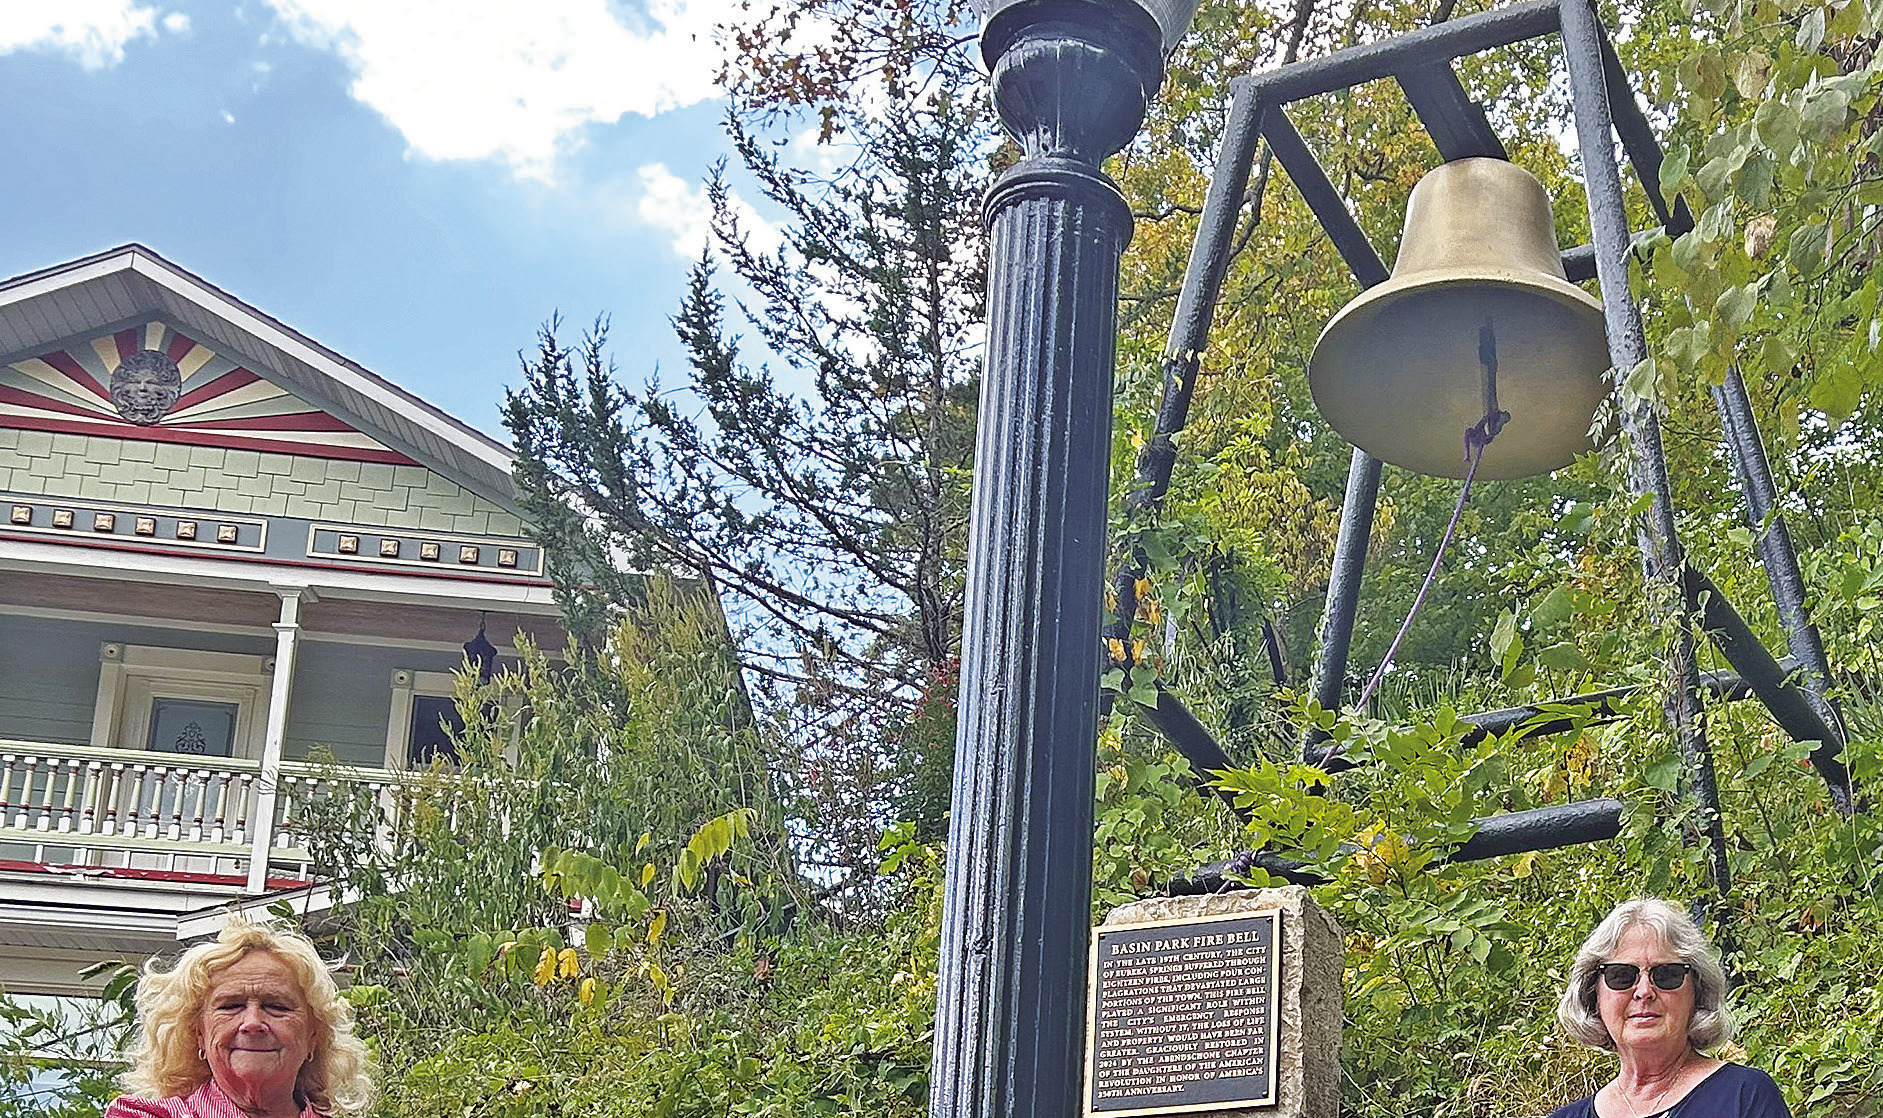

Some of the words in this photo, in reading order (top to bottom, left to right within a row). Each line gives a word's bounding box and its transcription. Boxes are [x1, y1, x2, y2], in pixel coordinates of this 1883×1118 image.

[1111, 941, 1151, 955] BASIN
[1155, 938, 1189, 951] PARK
[1193, 934, 1223, 948] FIRE
[1227, 931, 1260, 945] BELL
[1103, 961, 1113, 969] IN
[1117, 959, 1133, 968] THE
[1136, 957, 1156, 966] LATE
[1159, 955, 1179, 964] 19TH
[1226, 949, 1243, 958] THE
[1246, 947, 1267, 956] CITY
[1103, 971, 1115, 979] OF
[1116, 968, 1148, 978] EUREKA
[1150, 965, 1183, 975] SPRINGS
[1184, 961, 1225, 971] SUFFERED
[1225, 957, 1266, 968] THROUGH
[1102, 987, 1159, 999] FLAGRATIONS
[1160, 985, 1184, 993] THAT
[1185, 980, 1236, 991] DEVASTATED
[1239, 977, 1266, 986] LARGE
[1103, 978, 1145, 989] EIGHTEEN
[1172, 972, 1219, 983] INCLUDING
[1221, 969, 1243, 978] FOUR
[1101, 1009, 1133, 1019] PLAYED
[1149, 1003, 1202, 1014] SIGNIFICANT
[1207, 1000, 1228, 1009] ROLE
[1233, 997, 1265, 1007] WITHIN
[1102, 998, 1143, 1009] PORTIONS
[1144, 997, 1156, 1005] OF
[1157, 996, 1174, 1004] THE
[1204, 991, 1224, 999] THIS
[1226, 989, 1243, 997] FIRE
[1246, 987, 1266, 996] BELL
[1101, 1020, 1118, 1029] THE
[1164, 1012, 1215, 1023] EMERGENCY
[1224, 1007, 1265, 1018] RESPONSE
[1137, 1025, 1177, 1036] WITHOUT
[1192, 1022, 1209, 1031] THE
[1211, 1020, 1231, 1029] LOSS
[1233, 1019, 1244, 1027] OF
[1247, 1017, 1265, 1026] LIFE
[1101, 1040, 1120, 1049] AND
[1121, 1036, 1164, 1047] PROPERTY
[1168, 1033, 1199, 1043] WOULD
[1201, 1031, 1223, 1040] HAVE
[1225, 1029, 1247, 1038] BEEN
[1248, 1027, 1264, 1036] FAR
[1146, 1043, 1199, 1054] GRACIOUSLY
[1205, 1039, 1248, 1049] RESTORED
[1254, 1037, 1264, 1045] IN
[1099, 1071, 1110, 1079] OF
[1113, 1069, 1130, 1078] THE
[1133, 1064, 1183, 1076] DAUGHTERS
[1185, 1063, 1197, 1071] OF
[1199, 1061, 1217, 1070] THE
[1219, 1057, 1264, 1068] AMERICAN
[1122, 1059, 1132, 1067] BY
[1137, 1057, 1154, 1066] THE
[1225, 1047, 1264, 1058] CHAPTER
[1098, 1077, 1152, 1089] REVOLUTION
[1156, 1076, 1167, 1084] IN
[1170, 1073, 1201, 1083] HONOR
[1204, 1072, 1216, 1080] OF
